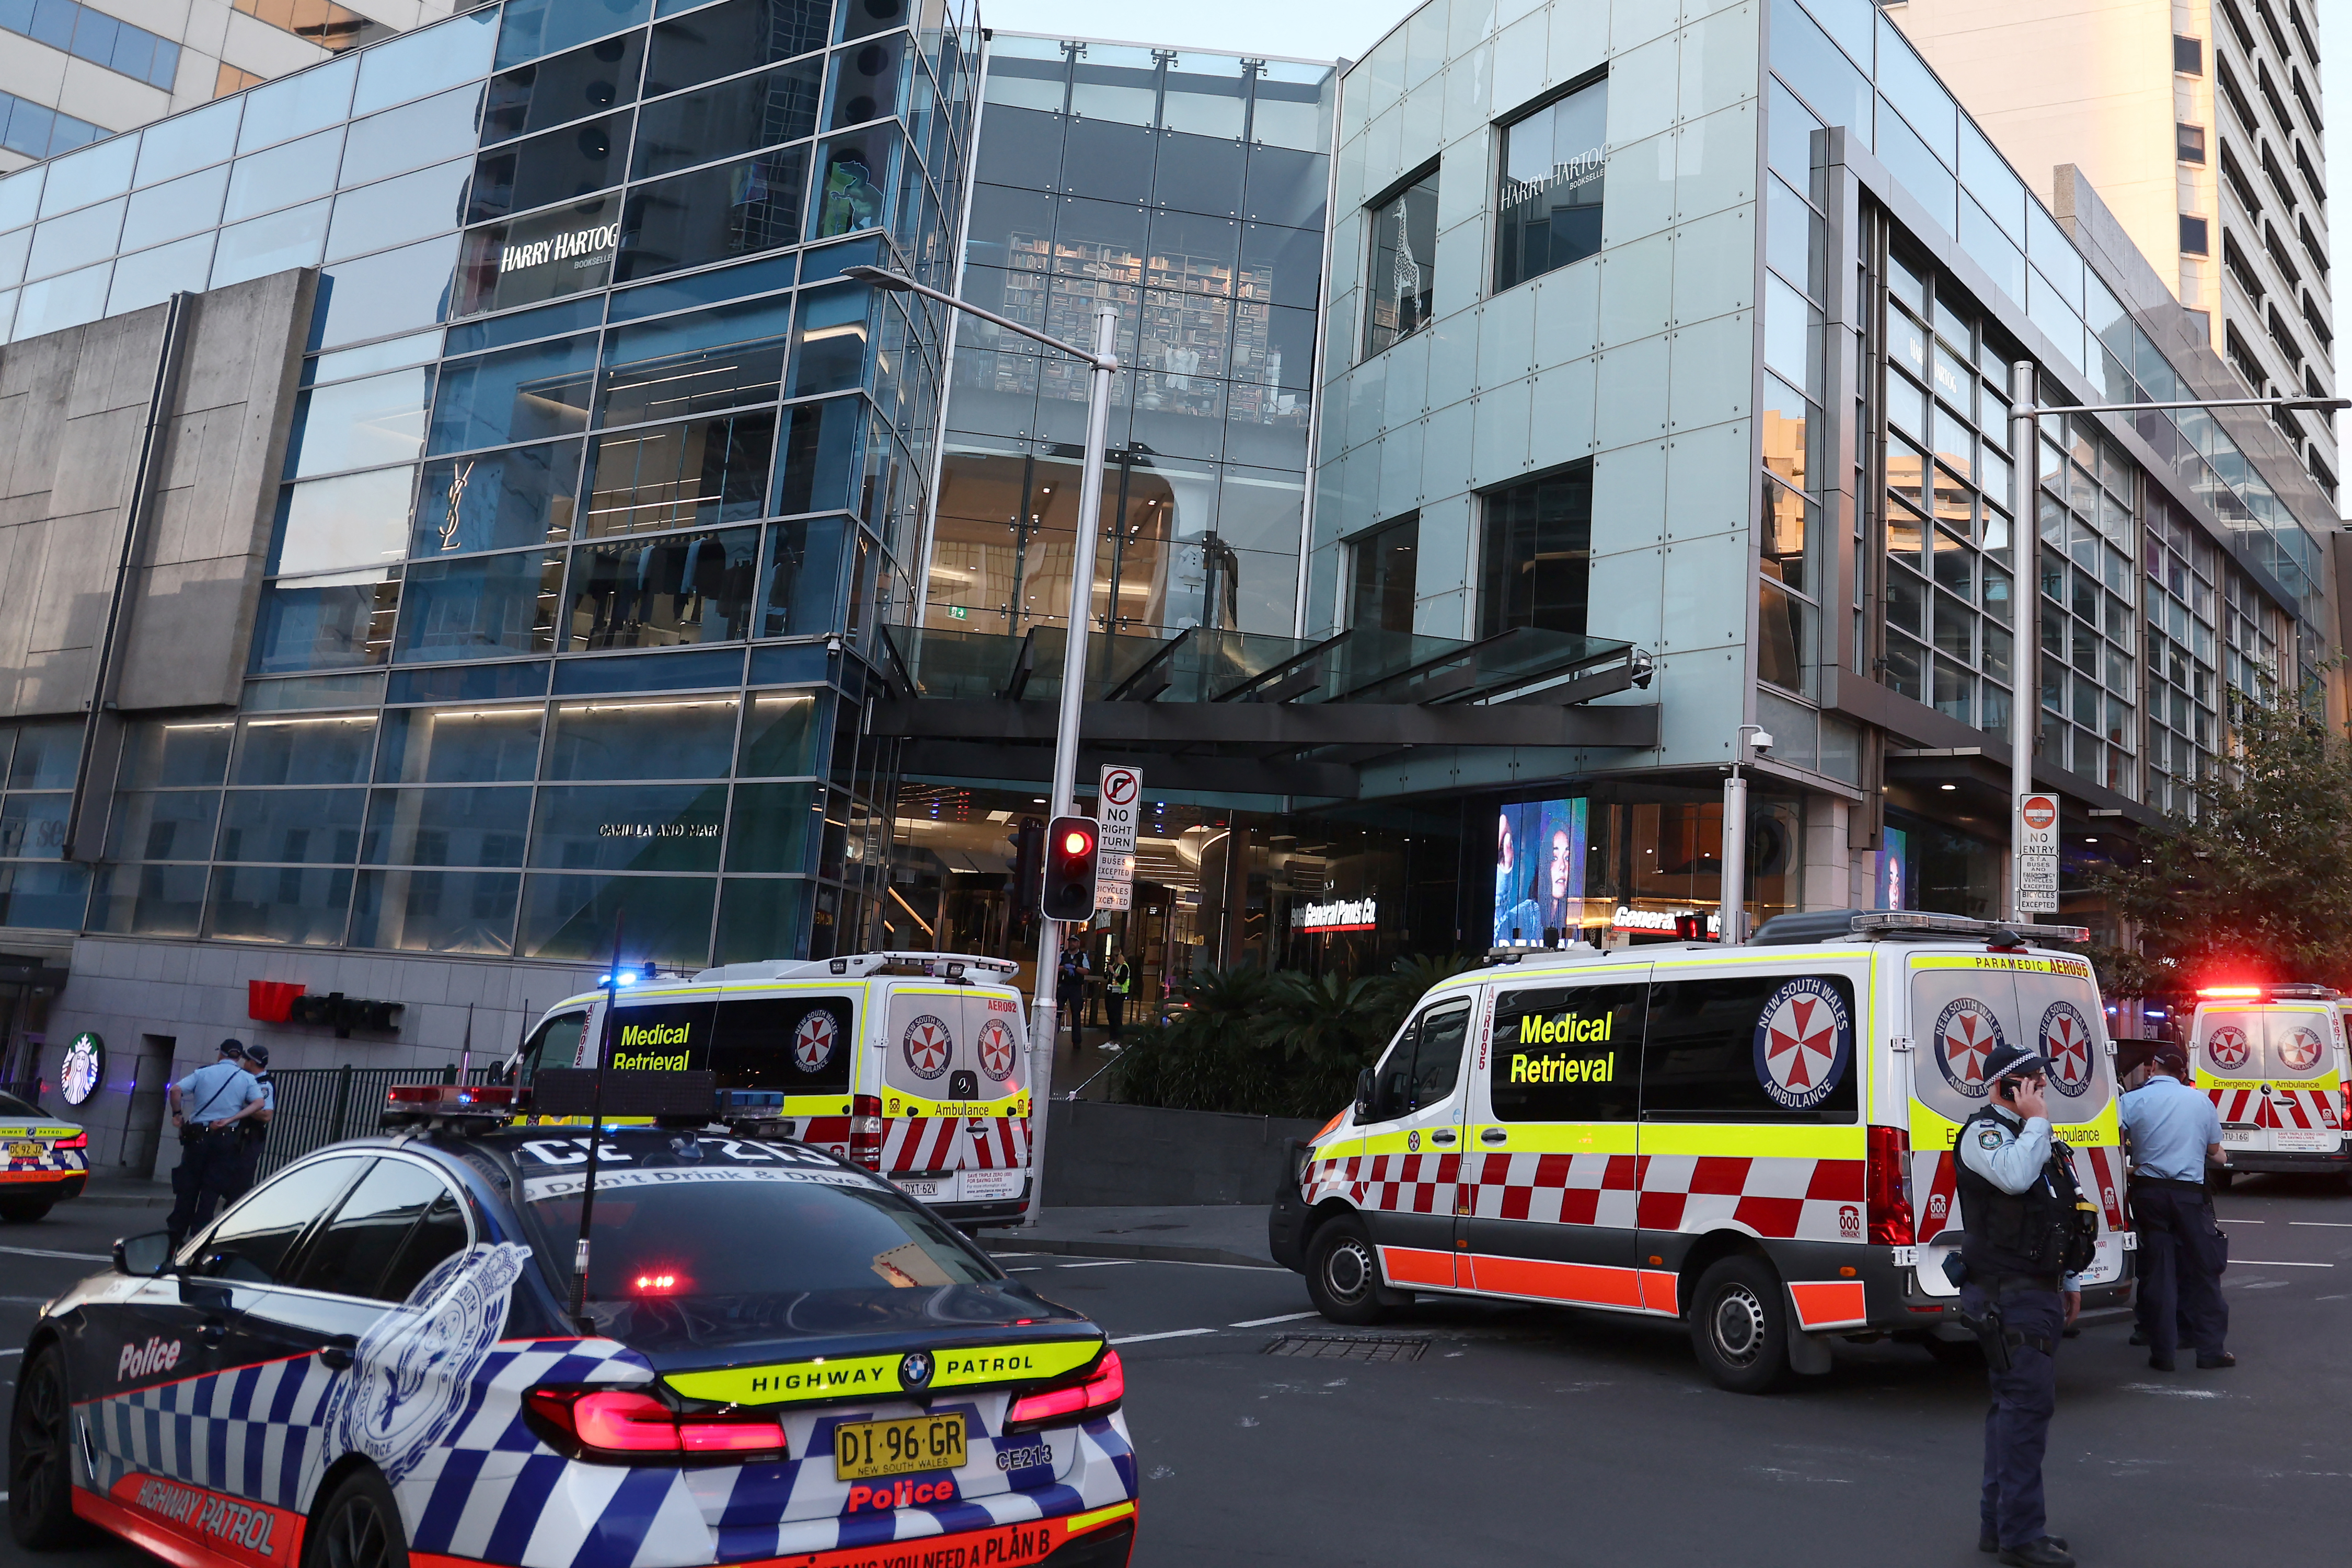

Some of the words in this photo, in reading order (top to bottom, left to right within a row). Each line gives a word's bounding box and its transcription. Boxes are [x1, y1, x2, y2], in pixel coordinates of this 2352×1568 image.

[1501, 170, 1547, 211] HARRY
[501, 239, 554, 273] HARRY
[554, 223, 618, 260] HARTOG
[1108, 809, 1128, 822] NO
[599, 824, 653, 837] CAMILLA
[656, 824, 684, 836] AND
[1101, 824, 1132, 835] RIGHT
[2031, 833, 2048, 842] NO
[1102, 837, 1130, 847] TURN
[1098, 867, 1129, 876] EXCEPTED
[1305, 900, 1339, 927] General
[1337, 900, 1362, 925] Pants
[1362, 897, 1376, 924] Co.
[1976, 958, 2044, 971] PARAMEDIC
[1759, 994, 1780, 1029] NEW
[1781, 979, 1820, 999] SOUTH
[1821, 984, 1848, 1031] WALES
[795, 1017, 806, 1034] NEW
[807, 1010, 826, 1020] SOUTH
[826, 1013, 838, 1035] WALES
[905, 1023, 916, 1040] NEW
[915, 1016, 936, 1024] SOUTH
[936, 1019, 951, 1042] WALES
[1520, 1011, 1612, 1044] Medical
[1935, 1010, 1950, 1037] NEW
[1949, 999, 1977, 1012] SOUTH
[1979, 1004, 2002, 1040] WALES
[2040, 1011, 2051, 1036] NEW
[2049, 1002, 2071, 1014] SOUTH
[2073, 1009, 2090, 1044] WALES
[621, 1022, 690, 1046] Medical
[979, 1028, 988, 1042] NEW
[1002, 1023, 1014, 1047] WALES
[2210, 1032, 2220, 1044] NEW
[2307, 1028, 2320, 1045] WALES
[614, 1050, 689, 1070] Retrieval
[795, 1058, 828, 1073] AMBULANCE
[1511, 1052, 1613, 1083] Retrieval
[2215, 1059, 2245, 1069] AMBULANCE
[2284, 1059, 2315, 1070] AMBULANCE
[911, 1065, 946, 1079] AMBULANCE
[984, 1067, 1011, 1081] AMBULANCE
[1764, 1079, 1833, 1108] AMBULANCE
[2050, 1075, 2089, 1096] AMBULANCE
[2213, 1080, 2256, 1089] Emergency
[935, 1103, 989, 1116] Ambulance
[2054, 1127, 2100, 1143] mbulance
[545, 1174, 647, 1194] Don't
[655, 1168, 739, 1183] Drink
[754, 1170, 777, 1181] &
[782, 1171, 862, 1187] Drive
[1930, 1202, 1946, 1213] 000
[2105, 1195, 2114, 1204] 000
[1840, 1216, 1859, 1230] 000
[118, 1336, 181, 1381] Police
[752, 1367, 884, 1392] HIGHWAY
[948, 1355, 1034, 1375] PATROL
[858, 1467, 878, 1477] NEW
[883, 1462, 914, 1474] SOUTH
[918, 1458, 948, 1470] WALES
[996, 1444, 1053, 1472] CE213
[848, 1481, 953, 1514] Police
[135, 1479, 202, 1524] HIGHWAY
[196, 1495, 275, 1557] PATROL
[924, 1548, 965, 1568] NEED
[970, 1545, 979, 1563] A
[1039, 1529, 1050, 1555] B
